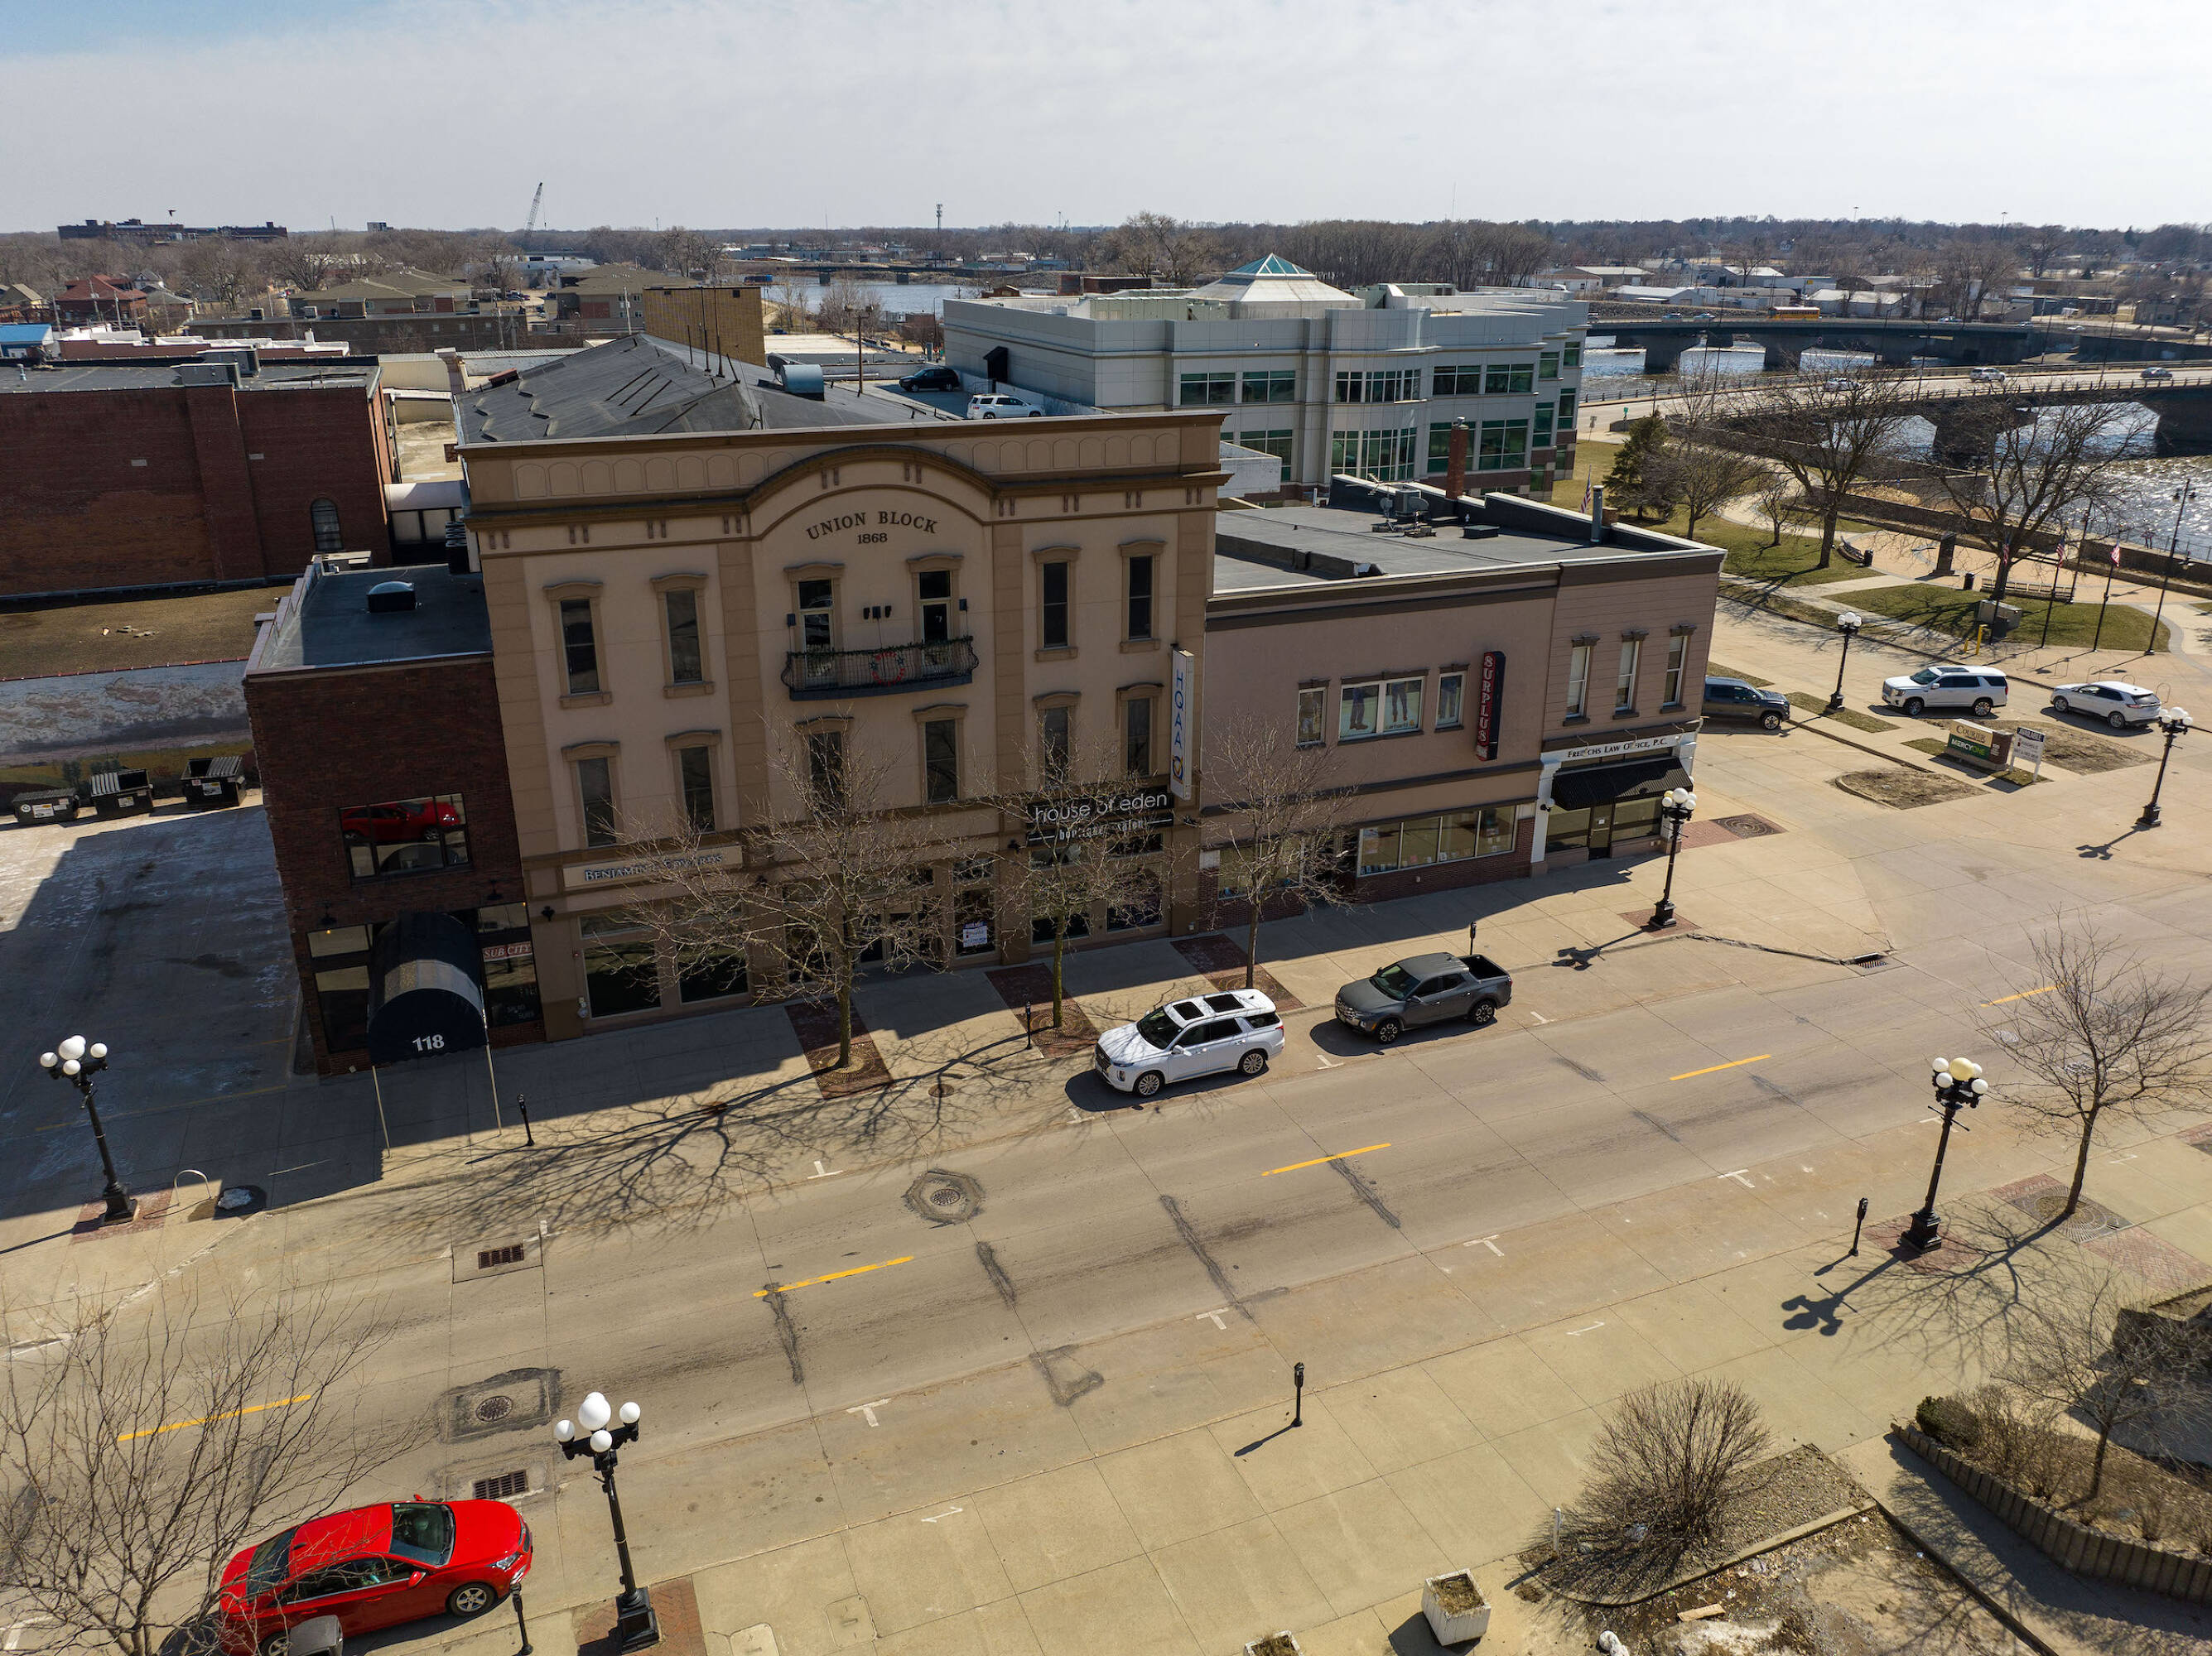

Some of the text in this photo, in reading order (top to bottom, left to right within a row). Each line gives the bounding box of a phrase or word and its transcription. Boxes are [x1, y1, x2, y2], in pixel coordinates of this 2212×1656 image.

[806, 511, 938, 540] UNION BLOCK
[857, 532, 888, 544] 1868
[1174, 669, 1183, 749] HQAA
[1478, 655, 1494, 742] SURPLUS
[1568, 748, 1602, 758] FRECHS
[1604, 745, 1621, 753] LAW
[1623, 742, 1651, 750] OICE,
[1034, 805, 1090, 824] house
[1120, 793, 1168, 812] eden
[484, 943, 533, 959] SUB CITY
[412, 1033, 445, 1052] 118
